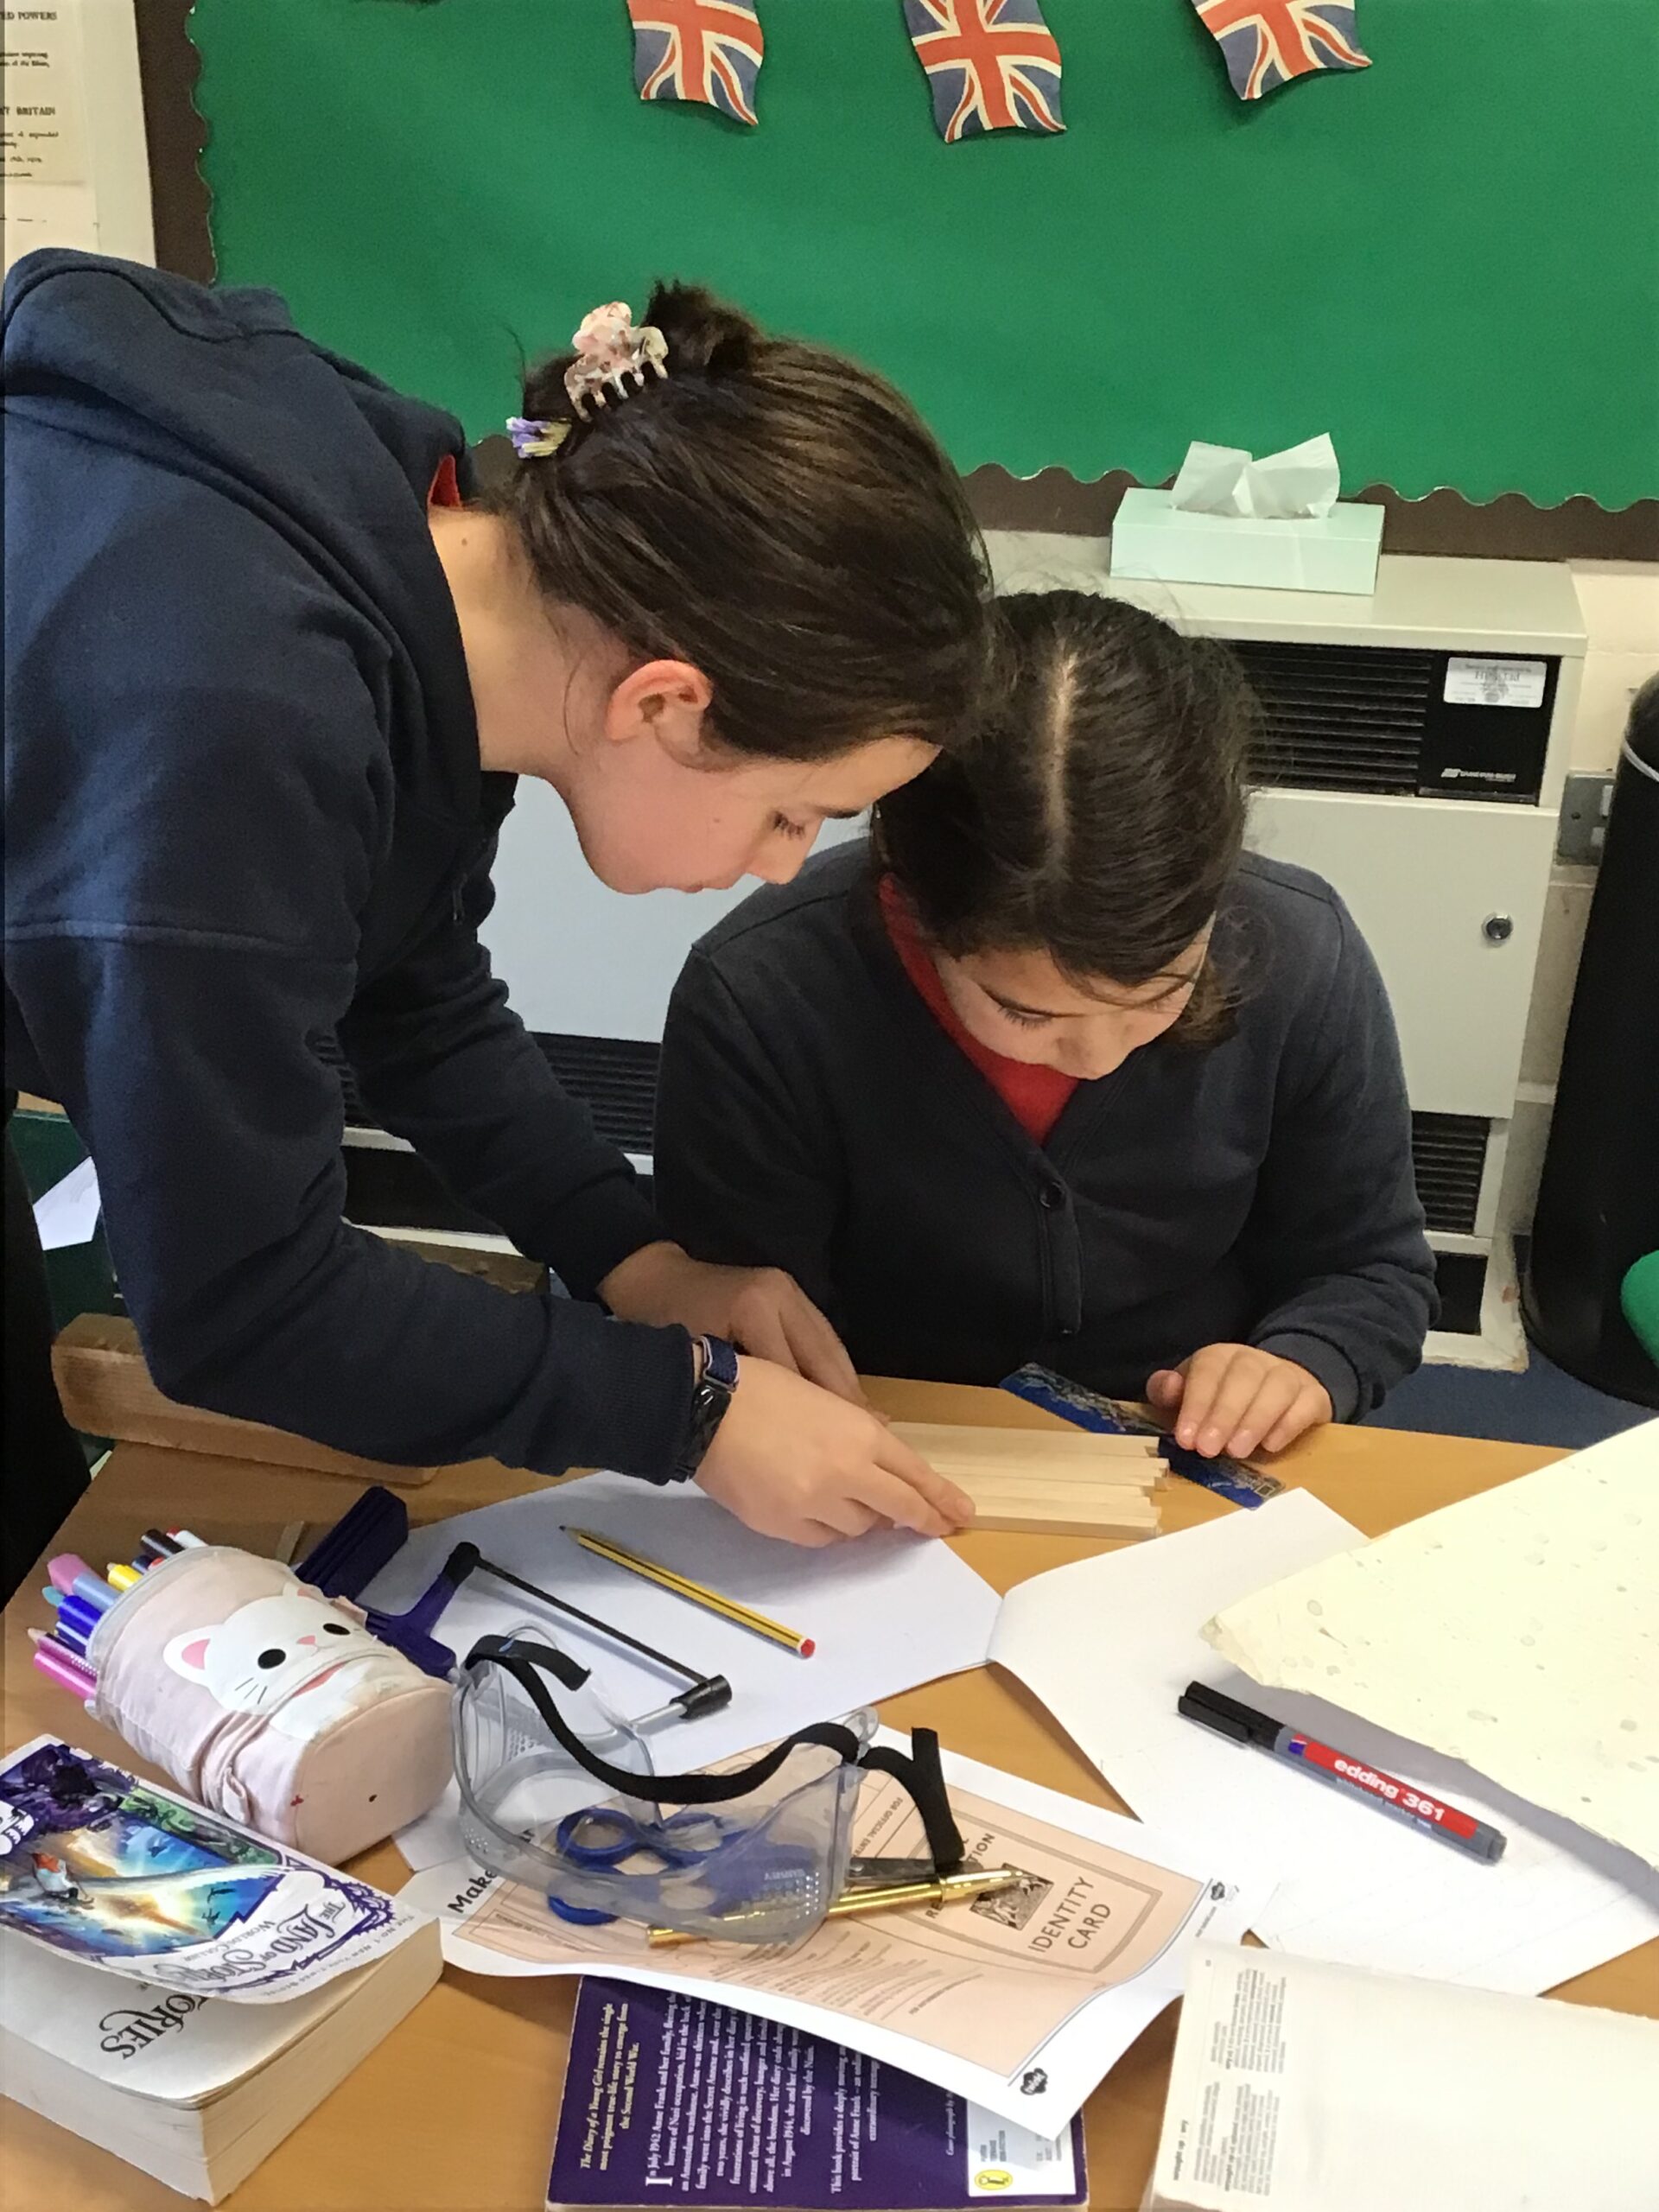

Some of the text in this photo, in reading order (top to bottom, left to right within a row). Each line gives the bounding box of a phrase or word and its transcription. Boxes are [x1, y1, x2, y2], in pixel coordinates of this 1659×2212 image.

[18, 11, 58, 20] POWERS
[16, 106, 56, 116] BRITAIN
[1334, 1759, 1399, 1799] edding
[1402, 1793, 1445, 1821] 361
[891, 1796, 903, 1811] FOR
[868, 1808, 893, 1839] OFFICIAL
[448, 1868, 499, 1914] Make
[319, 1902, 346, 1923] THE
[1028, 1876, 1094, 1953] IDENTITY
[270, 1904, 334, 1953] LAND
[1067, 1903, 1111, 1949] CARD
[259, 1951, 277, 1962] OF
[602, 2004, 614, 2024] single
[617, 2004, 628, 2021] from
[681, 2006, 691, 2023] back
[99, 1995, 209, 2060] ORIES
[600, 2025, 609, 2038] the
[679, 2024, 689, 2036] the
[712, 2021, 721, 2037] over
[726, 2016, 738, 2035] diary
[617, 2023, 628, 2050] emerge
[660, 2030, 675, 2055] family,
[677, 2037, 688, 2046] in
[693, 2023, 704, 2051] thirteen
[723, 2036, 734, 2049] her
[598, 2040, 607, 2069] remains
[676, 2047, 686, 2060] hid
[757, 2042, 766, 2056] and
[658, 2056, 670, 2069] her
[692, 2053, 702, 2067] was
[739, 2043, 751, 2075] confined
[787, 2048, 801, 2071] family
[593, 2069, 603, 2086] Girl
[613, 2061, 622, 2080] story
[658, 2071, 668, 2085] and
[690, 2069, 700, 2089] Anne
[720, 2060, 733, 2094] describes
[753, 2057, 767, 2085] hunger
[770, 2065, 783, 2085] diary
[786, 2073, 796, 2086] her
[803, 2070, 813, 2082] the
[620, 2043, 639, 2129] the Second World War.
[671, 2062, 685, 2106] occupation,
[738, 2077, 748, 2094] such
[769, 2086, 779, 2101] Her
[802, 2083, 815, 2094] by
[588, 2088, 603, 2110] Young
[607, 2082, 619, 2112] true-life
[655, 2087, 667, 2109] Frank
[703, 2086, 715, 2109] Secret
[785, 2088, 796, 2102] and
[834, 2088, 847, 2113] deeply
[718, 2095, 732, 2121] vividly
[751, 2087, 765, 2124] discovery,
[785, 2103, 795, 2116] she
[800, 2095, 811, 2135] discovered
[850, 2095, 861, 2117] Frank
[652, 2112, 664, 2132] Anne
[669, 2107, 680, 2125] Nazi
[702, 2111, 712, 2123] the
[735, 2106, 748, 2127] living
[602, 2114, 614, 2149] poignant
[669, 2126, 679, 2135] of
[700, 2125, 711, 2141] into
[717, 2123, 728, 2136] she
[734, 2128, 744, 2138] of
[751, 2124, 760, 2133] of
[833, 2120, 846, 2152] provides
[850, 2119, 860, 2139] Anne
[583, 2130, 598, 2152] Diary
[650, 2133, 660, 2152] 1942
[749, 2135, 760, 2158] threat
[766, 2141, 776, 2154] the
[849, 2139, 859, 2150] of
[600, 2151, 609, 2170] most
[647, 2153, 661, 2168] July
[665, 2137, 677, 2165] horrors
[680, 2134, 693, 2179] Amsterdam
[700, 2143, 710, 2162] went
[782, 2139, 795, 2166] August
[581, 2153, 591, 2169] The
[715, 2162, 724, 2177] two
[730, 2139, 743, 2184] frustrations
[831, 2154, 842, 2173] book
[849, 2152, 861, 2181] portrait
[696, 2164, 709, 2189] family
[748, 2159, 759, 2193] constant
[764, 2170, 774, 2192] above
[781, 2168, 791, 2177] in
[682, 2181, 689, 2191] an
[831, 2175, 842, 2193] This
